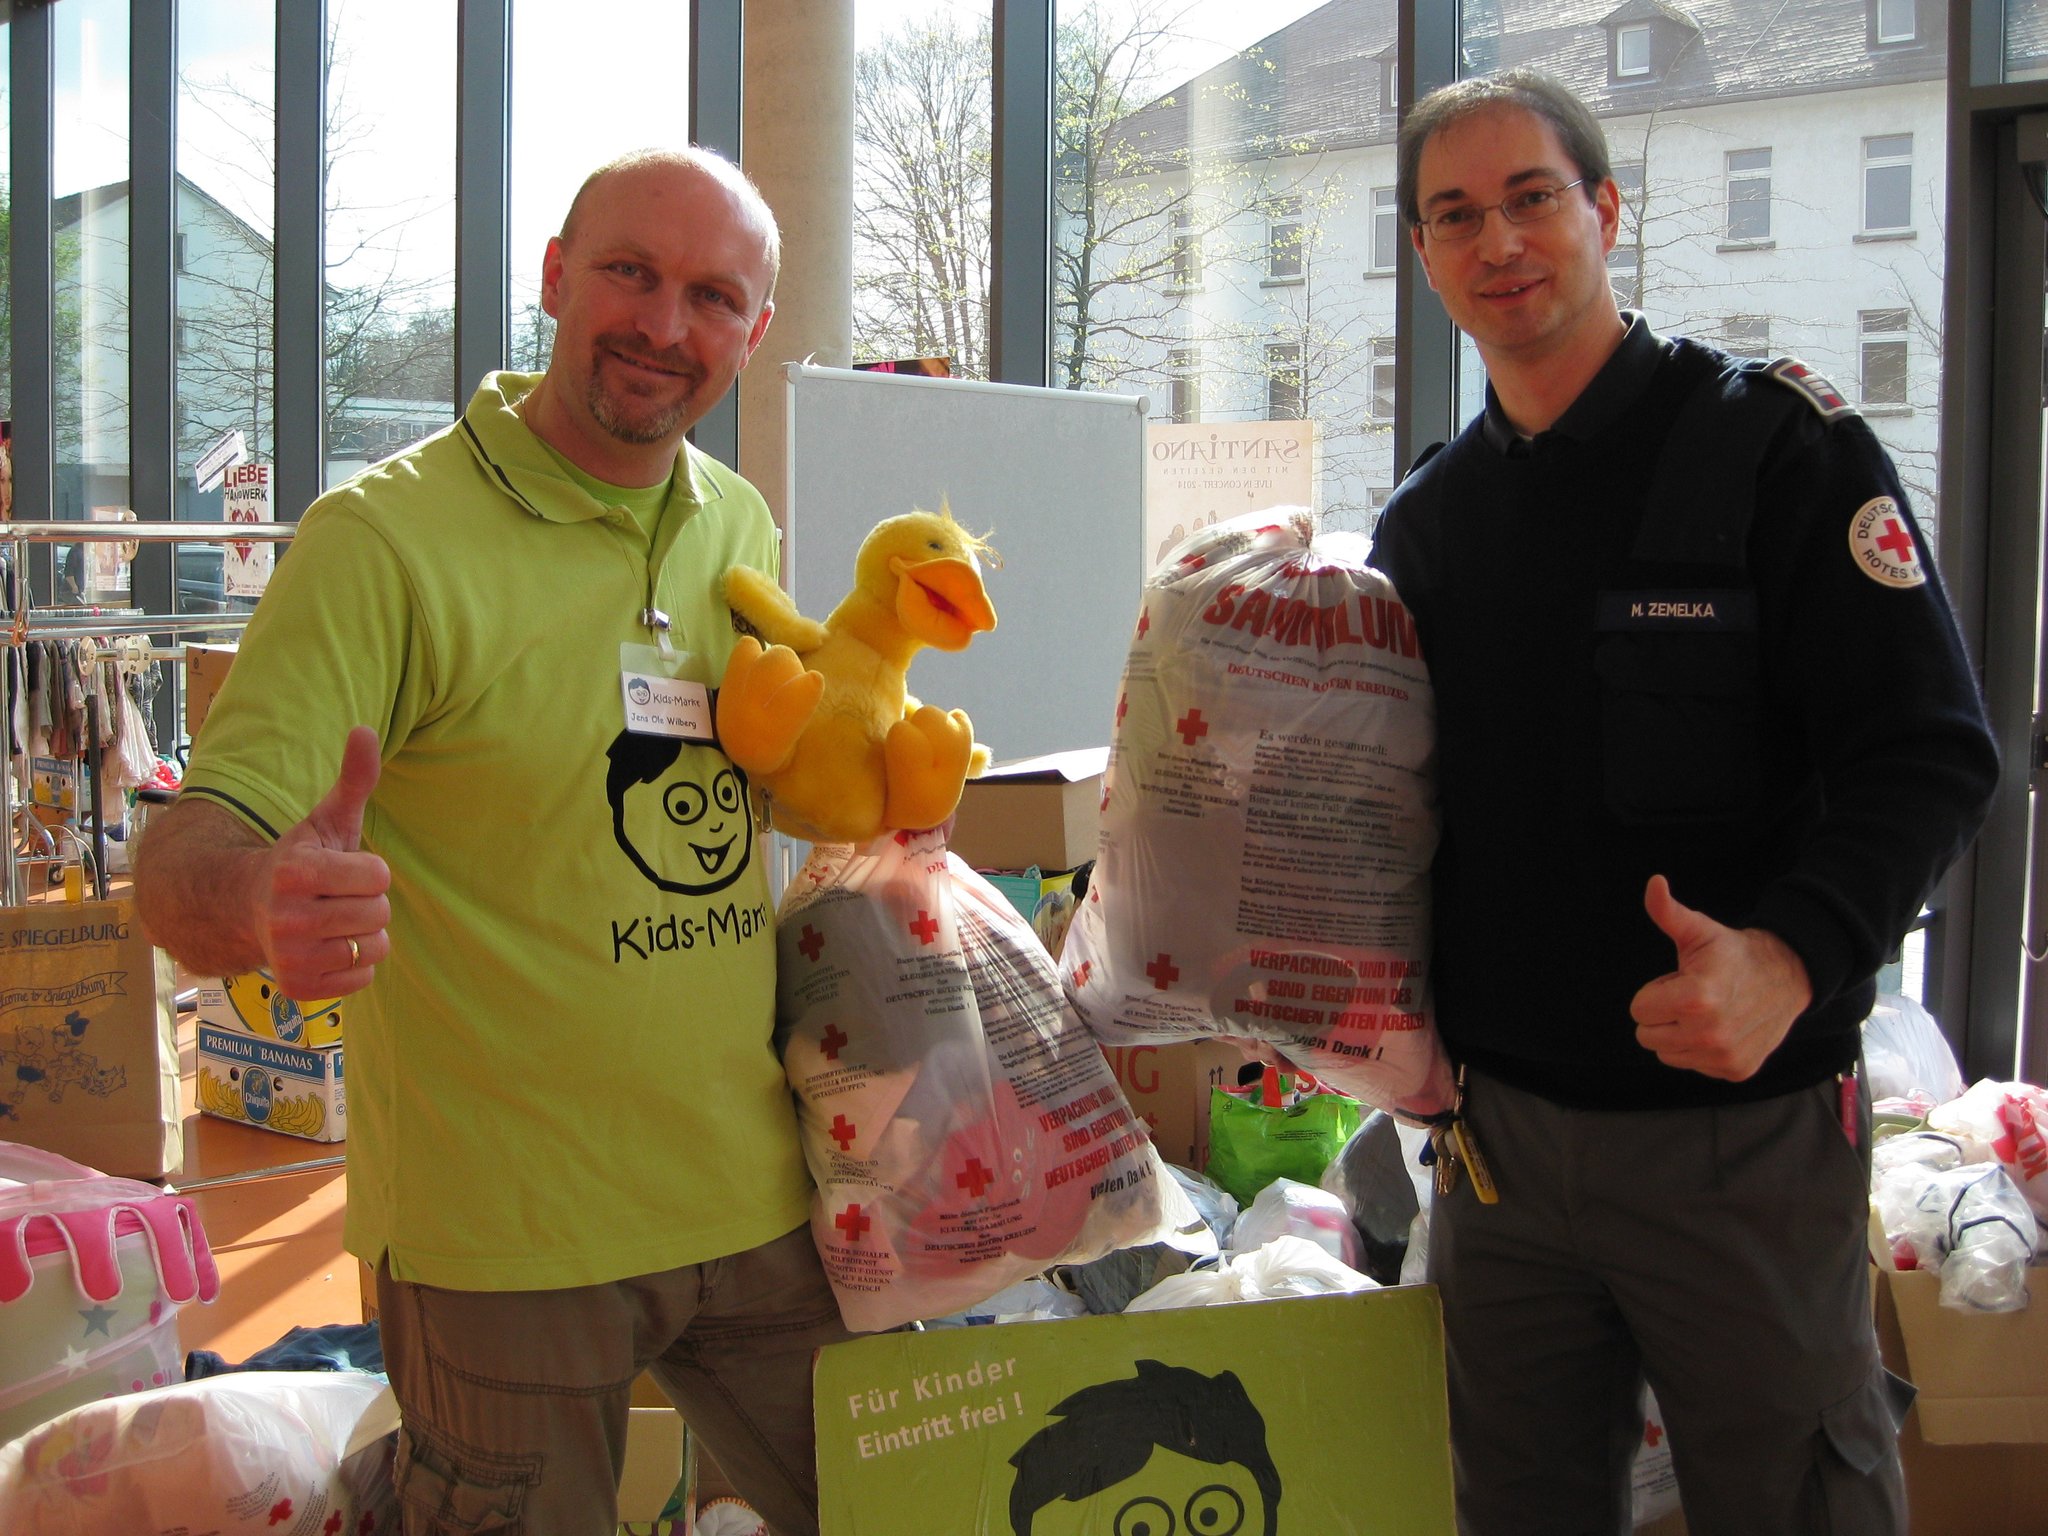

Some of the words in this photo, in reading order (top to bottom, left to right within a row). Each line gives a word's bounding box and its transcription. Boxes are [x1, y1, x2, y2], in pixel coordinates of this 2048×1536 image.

[224, 464, 268, 487] LIEBE
[1857, 503, 1896, 539] DEUTSC
[1862, 549, 1908, 579] ROTES
[1202, 584, 1424, 660] SAMMLUN
[1648, 602, 1715, 617] ZEMELKA
[1227, 663, 1309, 688] DEUTSCHEN
[1355, 681, 1409, 700] KREUZES
[653, 693, 700, 707] Kids-Markt
[631, 713, 648, 722] Jens
[652, 716, 664, 724] Ole
[667, 717, 696, 729] Wilberg
[1259, 729, 1273, 741] Es
[1278, 734, 1321, 746] werden
[1324, 739, 1388, 756] gesammelt:
[11, 923, 128, 948] SPIEGELBURG
[1249, 950, 1352, 978] VERPACKUNG
[1359, 960, 1386, 979] UND
[31, 989, 42, 1001] to
[1266, 979, 1305, 999] SIND
[1312, 983, 1387, 1005] EIGENTUM
[1391, 987, 1412, 1004] DES
[1234, 999, 1324, 1025] DEUTSCHEN
[1328, 1011, 1377, 1031] ROTEN
[206, 1035, 252, 1057] PREMIUM
[261, 1047, 313, 1071] BANANAS
[1331, 1040, 1373, 1060] Dank
[1038, 1092, 1100, 1132] VERPACKUNG
[1097, 1084, 1116, 1105] UND
[1062, 1127, 1091, 1153] SIND
[1044, 1145, 1111, 1190] DEUTSCHEN
[852, 1250, 889, 1259] SOZIALER
[848, 1388, 899, 1419] Für
[912, 1357, 1017, 1401] Kinder
[857, 1413, 954, 1459] Eintritt
[960, 1397, 1006, 1431] frei
